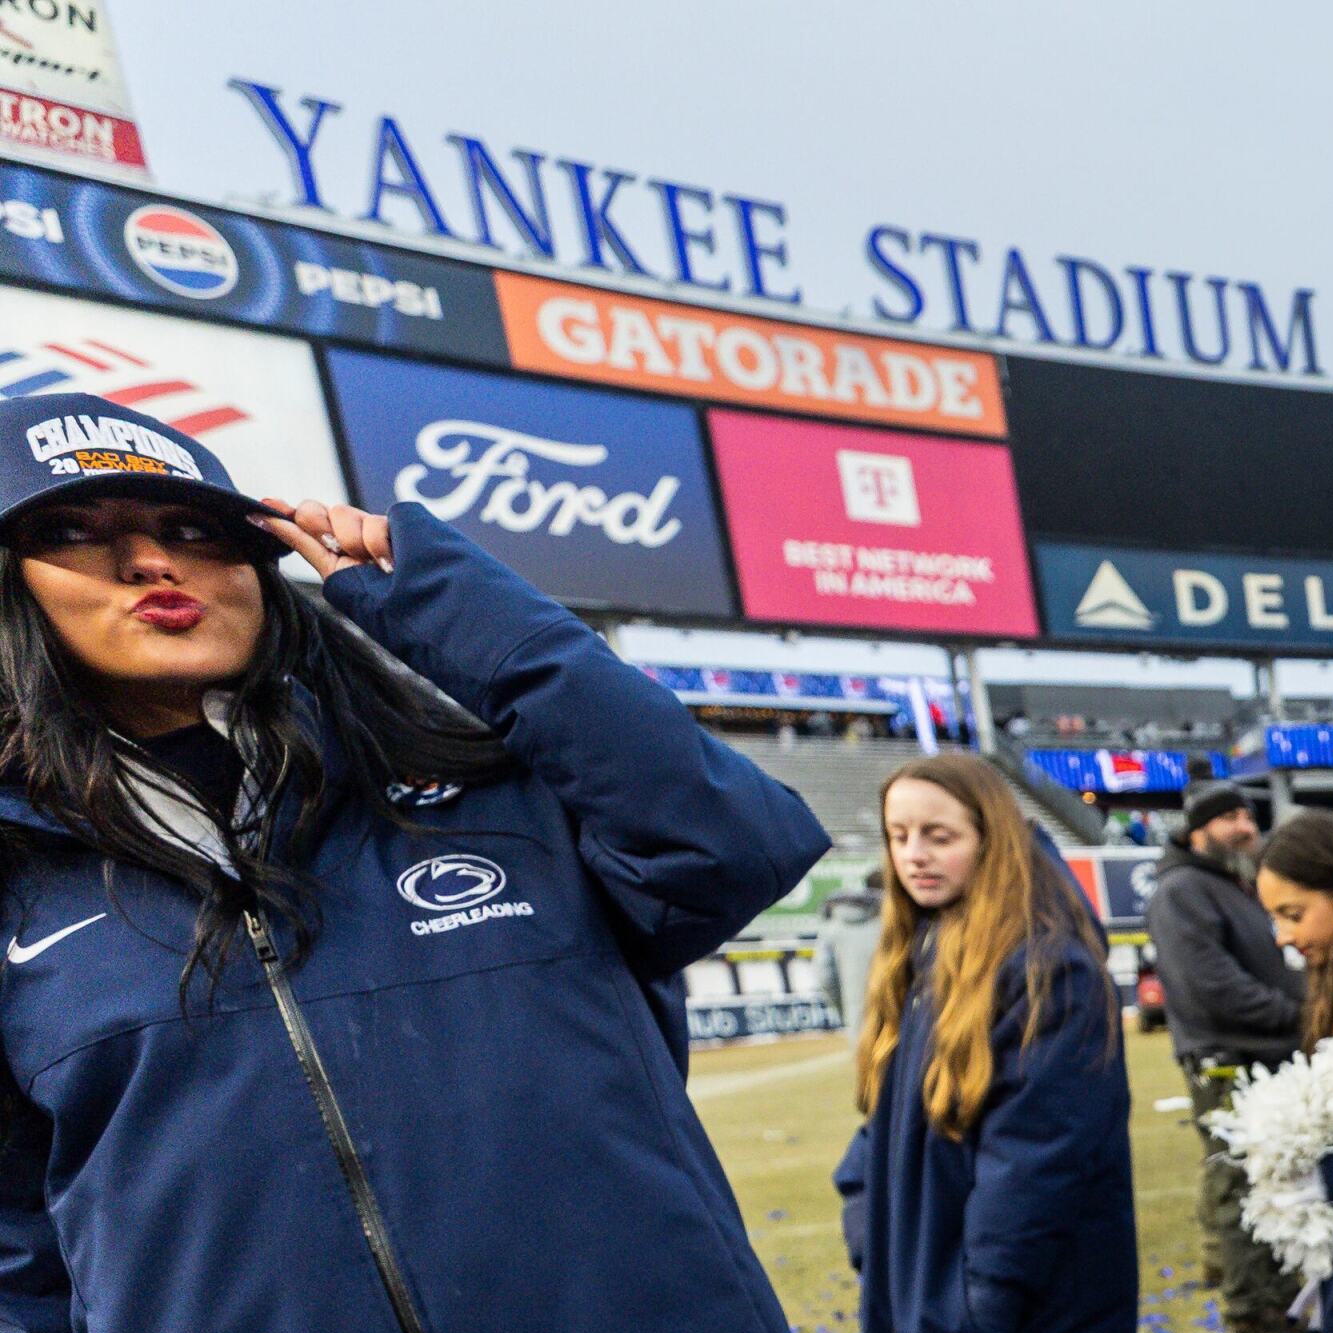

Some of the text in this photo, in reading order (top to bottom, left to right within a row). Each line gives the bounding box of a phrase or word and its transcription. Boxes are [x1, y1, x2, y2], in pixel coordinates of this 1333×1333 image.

[0, 199, 65, 243] SI
[228, 76, 1326, 377] YANKEE STADIUM
[136, 234, 228, 269] PEPSI
[295, 260, 444, 321] PEPSI
[536, 297, 985, 419] GATORADE
[26, 415, 203, 481] CHAMPIONS
[49, 458, 80, 475] 20
[76, 451, 166, 470] BAD BOY
[394, 419, 683, 549] Ford
[783, 539, 995, 584] BEST NETWORK
[814, 569, 976, 606] IN AMERICA
[410, 901, 535, 937] CHEERLEADING
